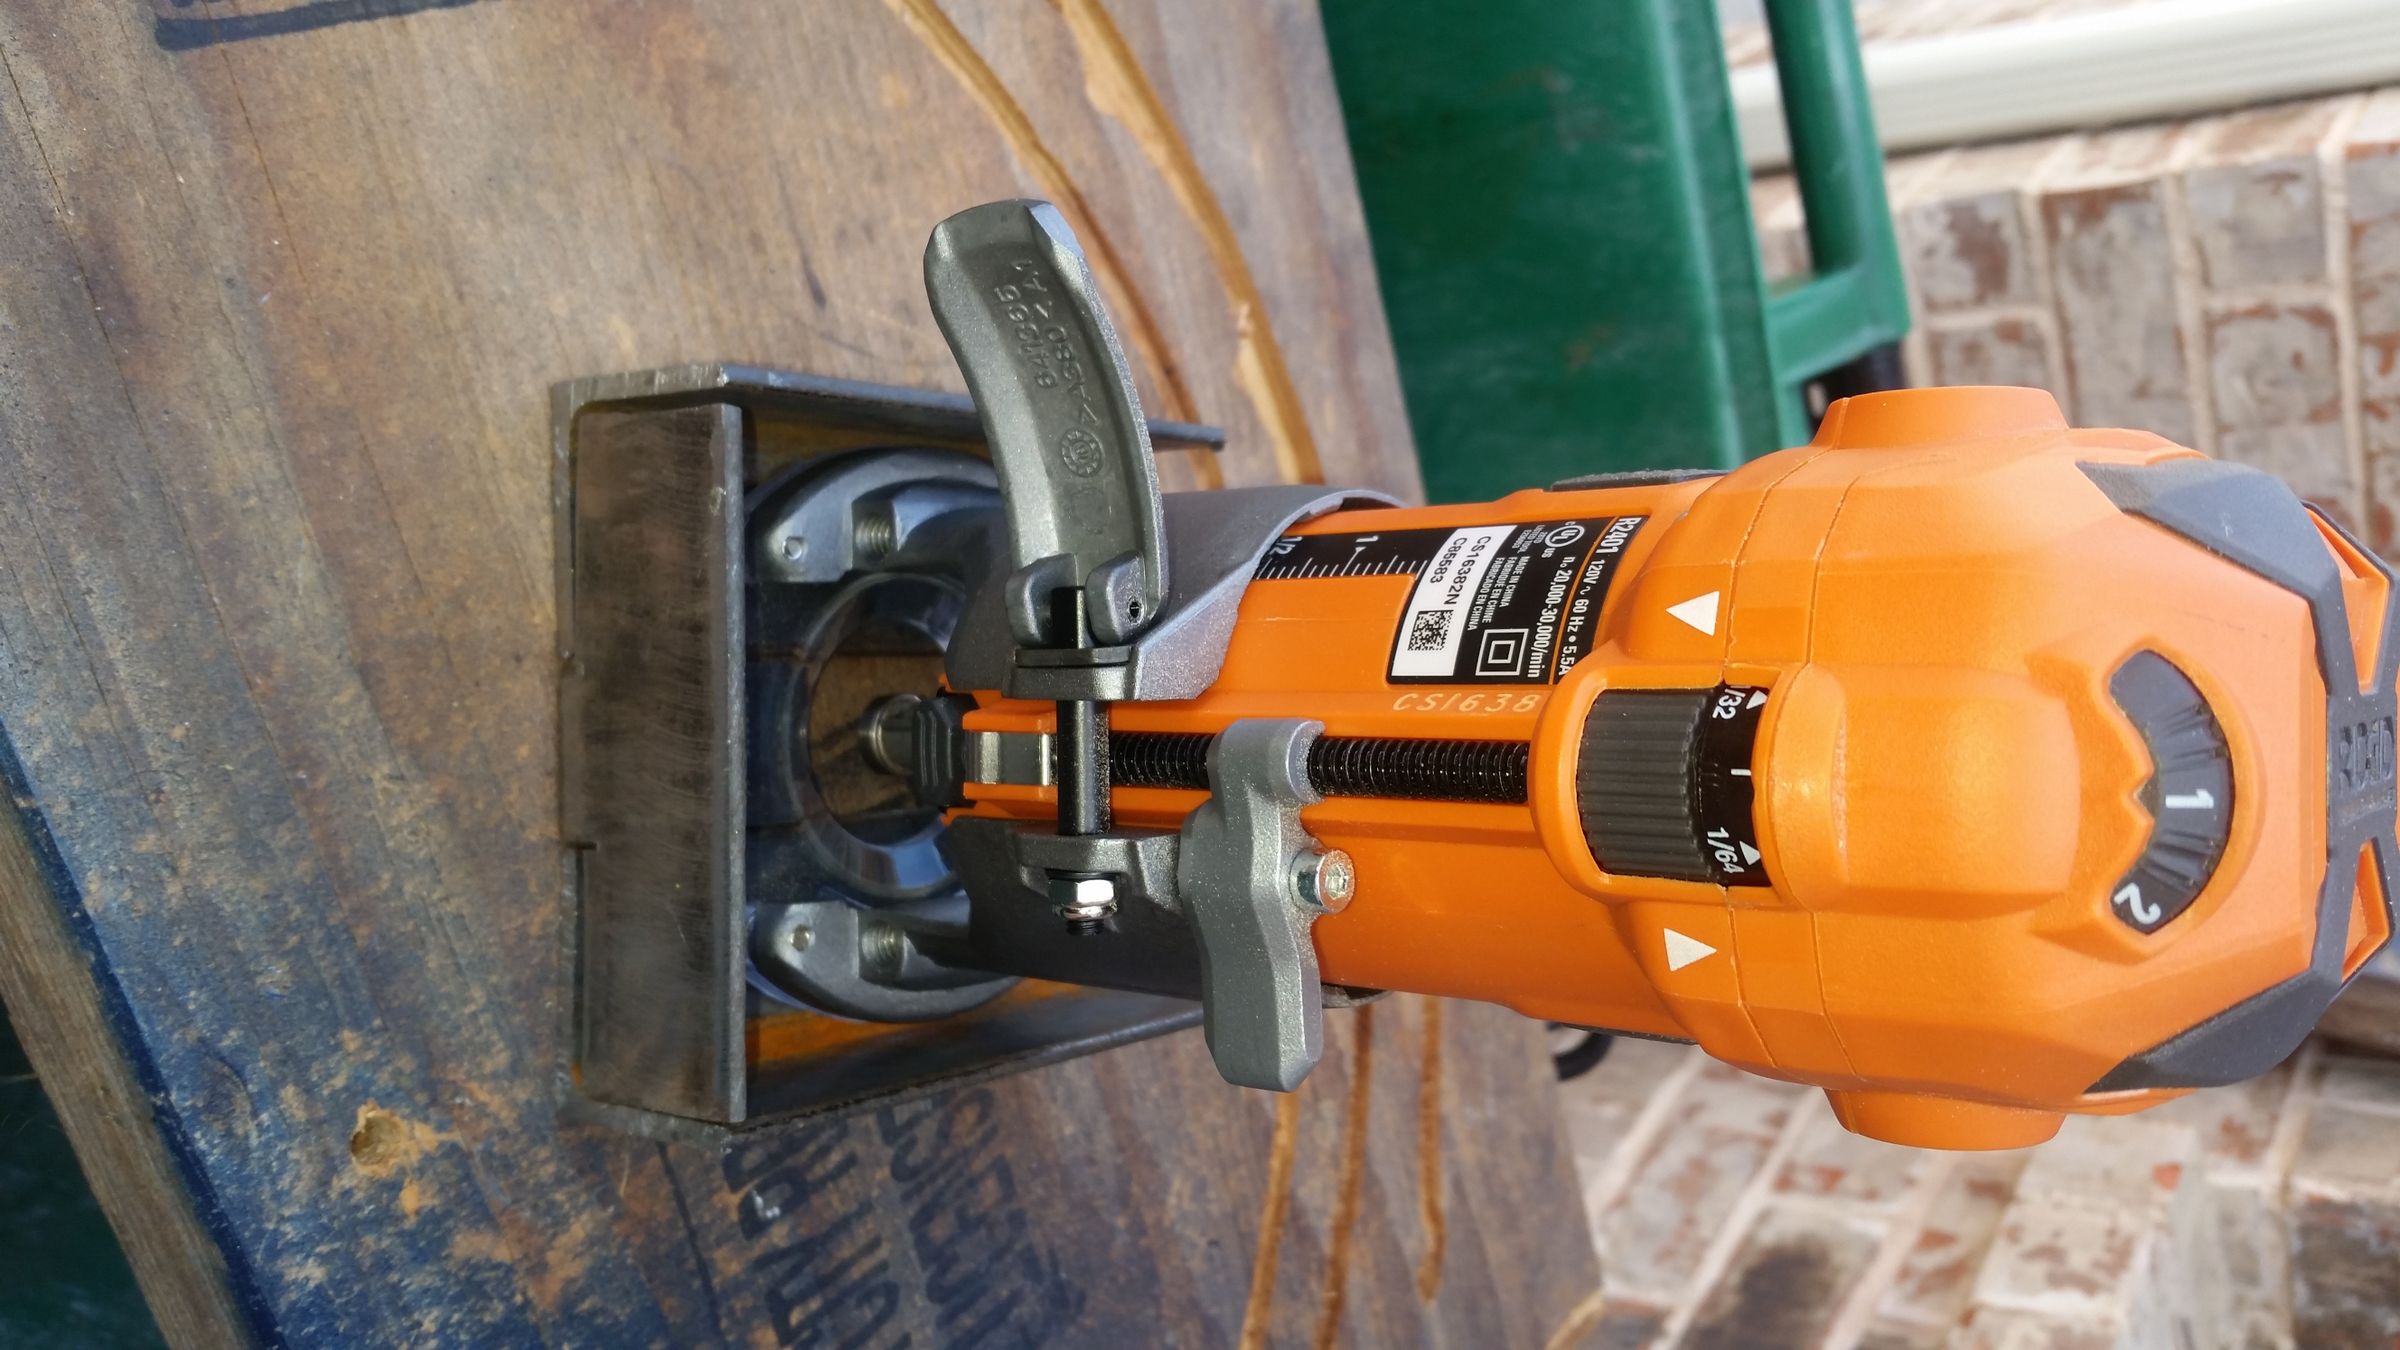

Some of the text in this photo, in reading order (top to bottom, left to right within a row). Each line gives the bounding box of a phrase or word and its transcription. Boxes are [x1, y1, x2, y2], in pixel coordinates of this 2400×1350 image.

[1430, 537, 1467, 584] C85583
[1444, 535, 1491, 606] CS16382N
[1482, 556, 1518, 624] FABRIQUE EN CHINE
[1499, 555, 1530, 608] MADE IN CHINA
[1467, 556, 1506, 632] FABRICADO EN CHINA
[1527, 569, 1573, 678] 20,000-30,000/min
[1559, 517, 1641, 675] R2401 120V 60 Hz 5.5A
[2165, 788, 2214, 809] 1
[1706, 826, 1744, 875] 1/64
[2113, 882, 2161, 925] 2
